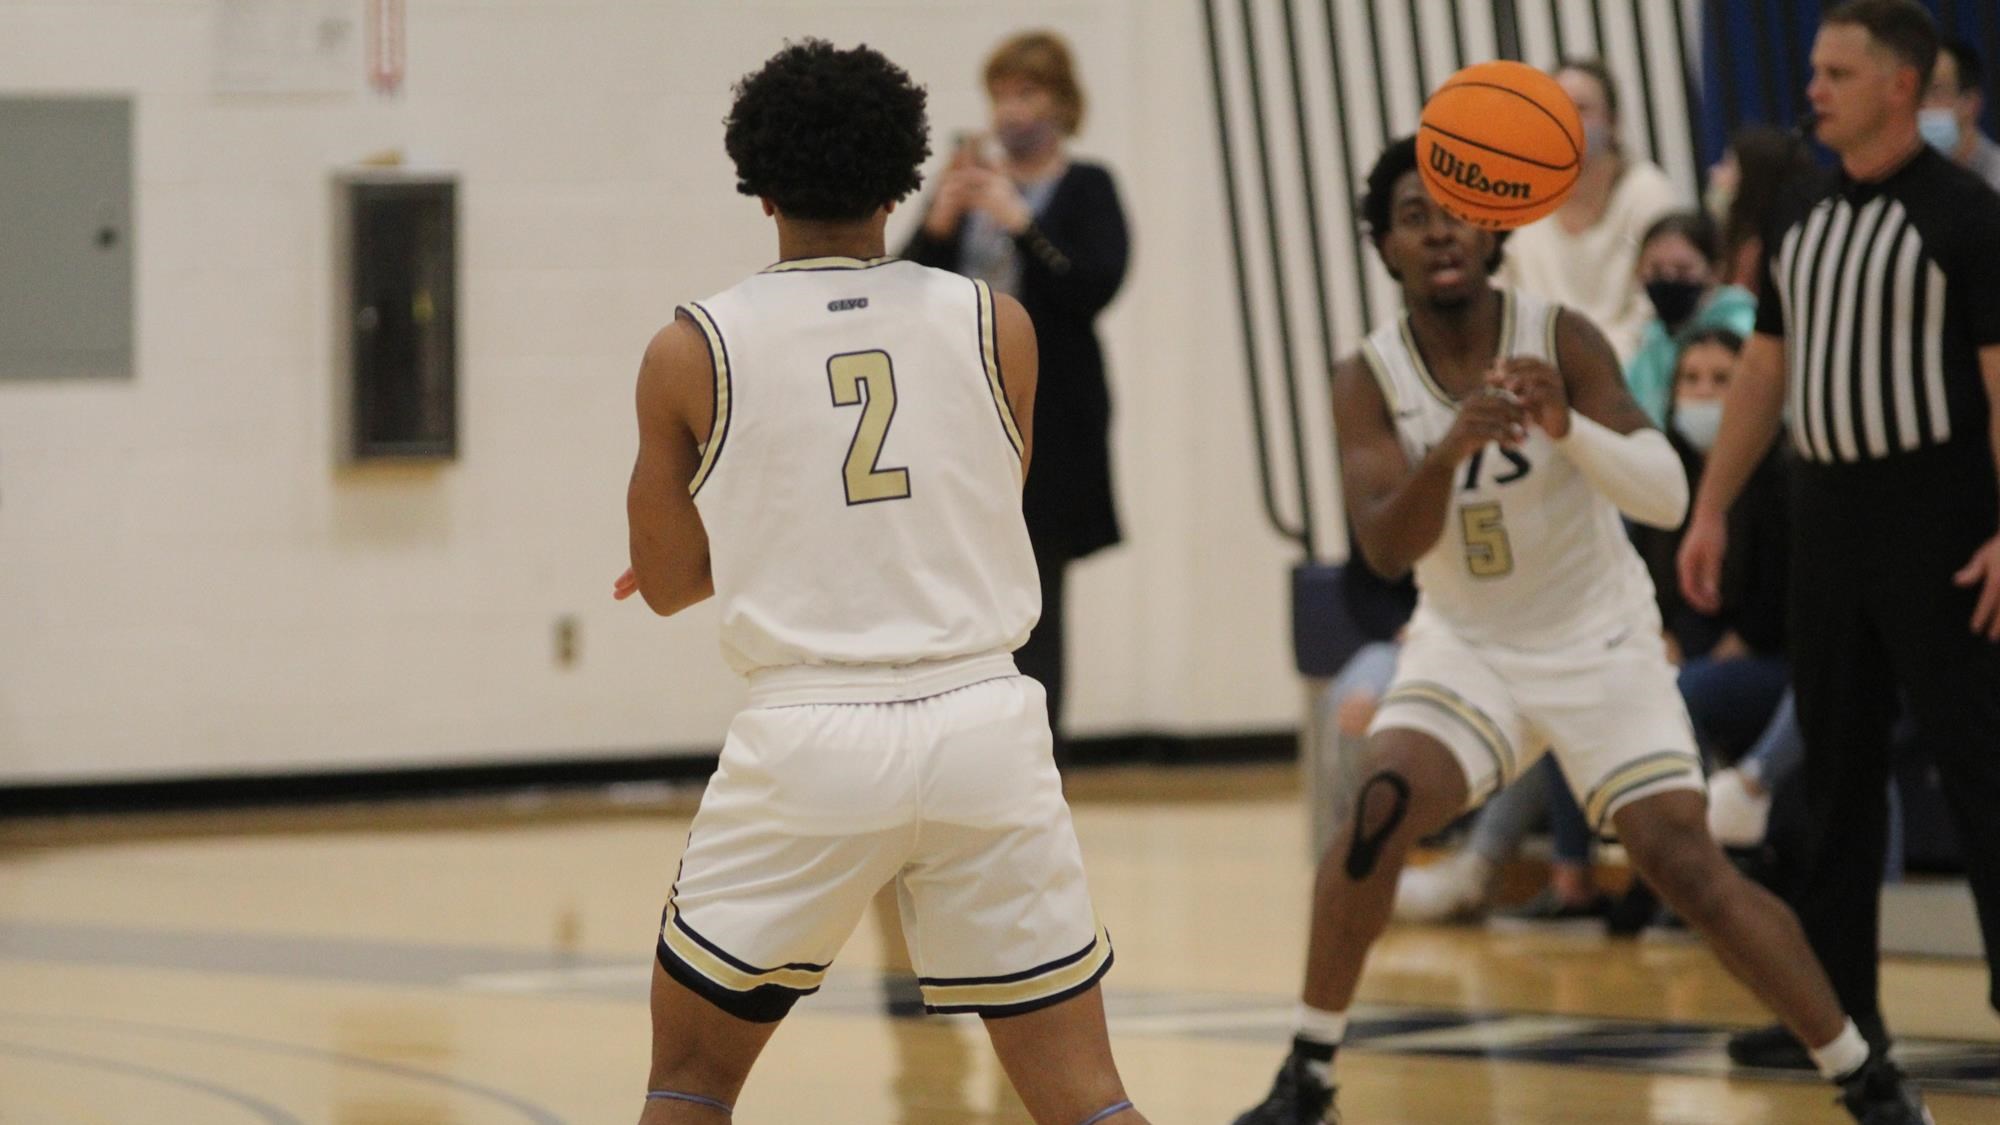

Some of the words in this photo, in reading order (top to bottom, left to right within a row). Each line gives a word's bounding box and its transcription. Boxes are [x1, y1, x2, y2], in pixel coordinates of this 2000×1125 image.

[1430, 141, 1531, 199] Wilson
[826, 349, 911, 506] 2
[1460, 503, 1514, 578] 5
